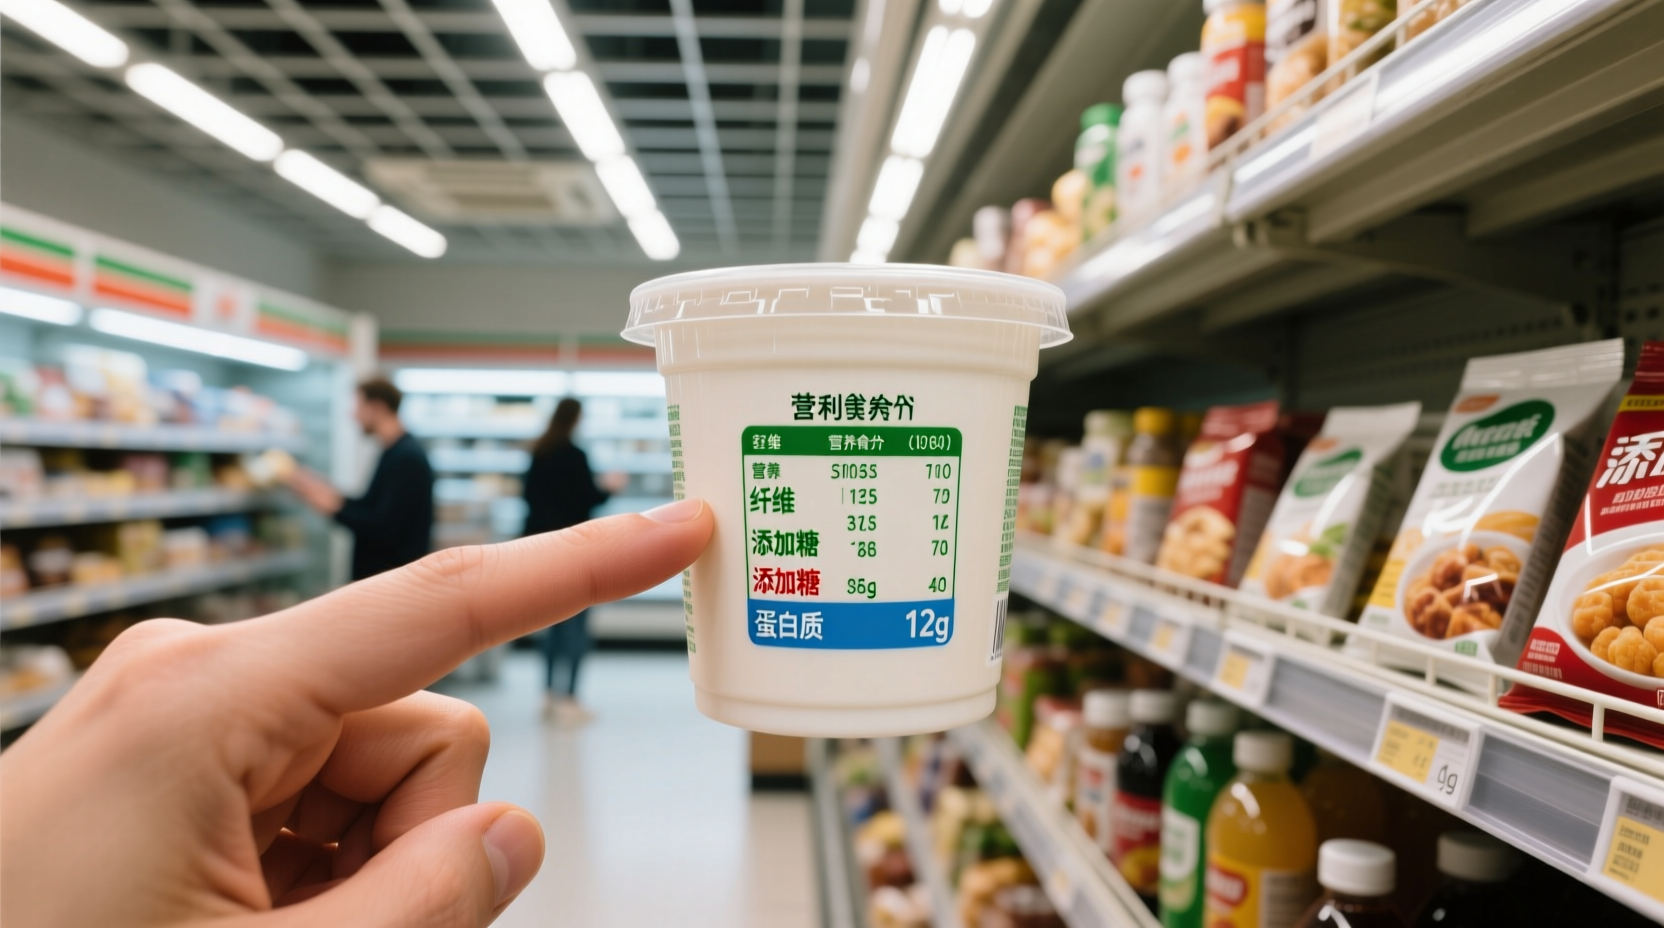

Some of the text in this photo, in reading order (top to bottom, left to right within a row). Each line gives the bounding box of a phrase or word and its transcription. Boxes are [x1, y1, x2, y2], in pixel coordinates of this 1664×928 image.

[750, 486, 795, 514] 纤维
[751, 529, 820, 557] 添加糖
[753, 567, 821, 596] 添加糖
[754, 608, 950, 643] 蛋白质 12g
